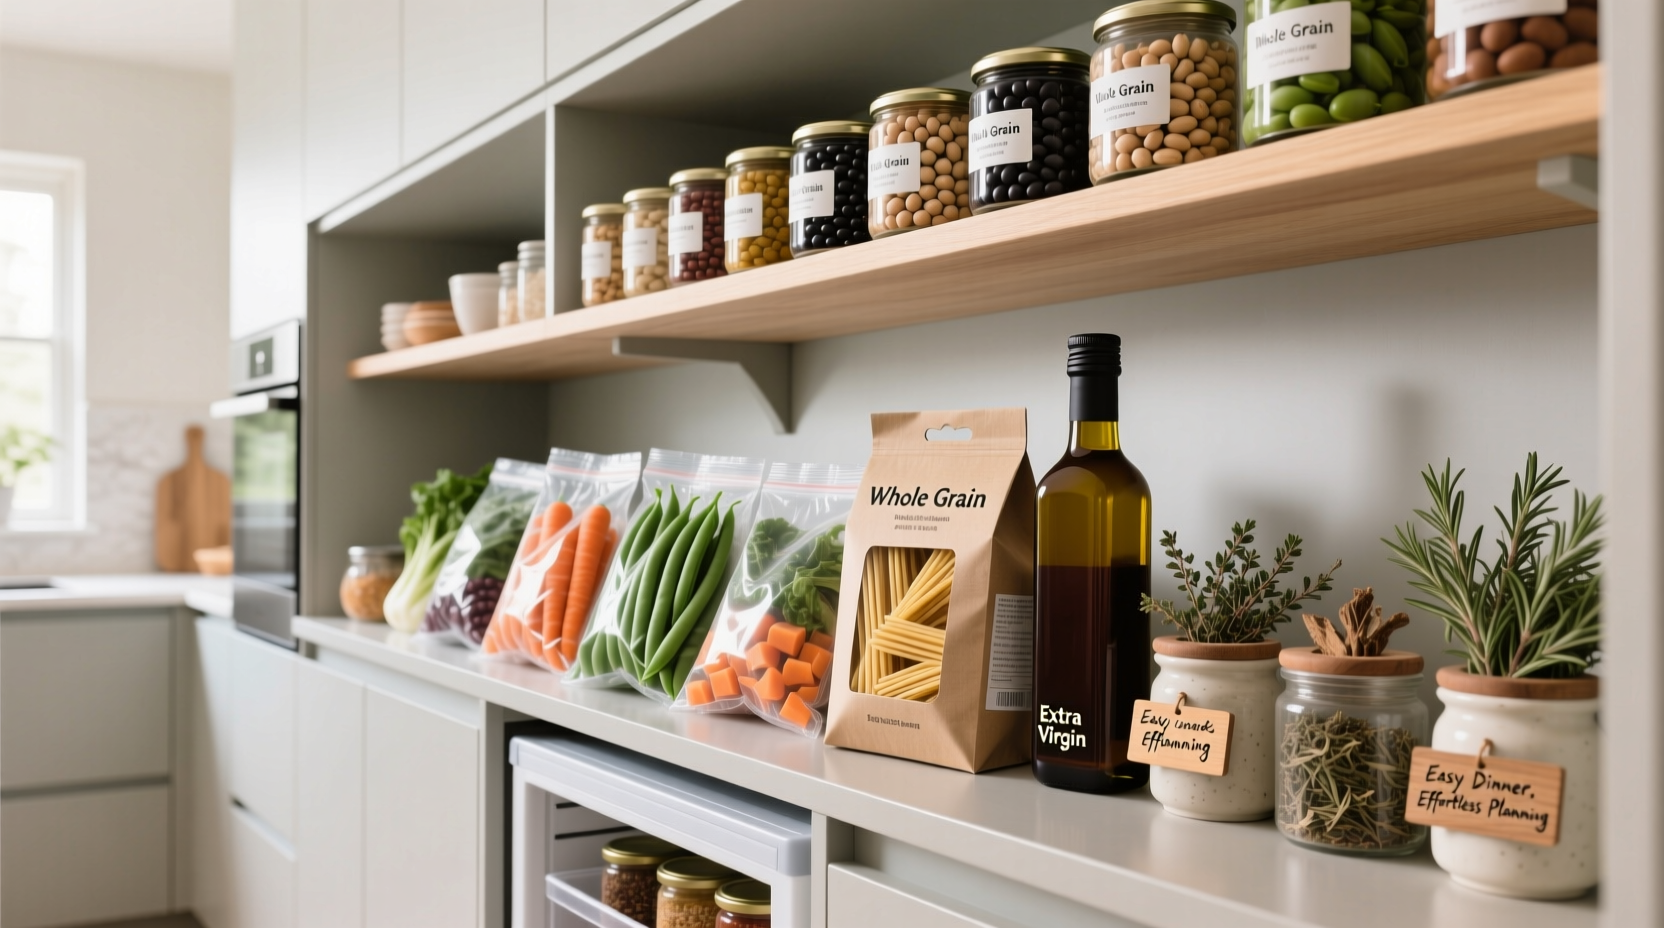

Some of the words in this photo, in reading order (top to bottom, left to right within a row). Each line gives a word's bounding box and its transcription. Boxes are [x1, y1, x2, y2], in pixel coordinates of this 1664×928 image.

[1291, 20, 1334, 38] Grain
[1118, 80, 1155, 97] Grain
[990, 121, 1020, 137] Grain
[870, 486, 929, 507] Whole
[933, 487, 987, 508] Grain
[1040, 704, 1082, 726] Extra
[1037, 724, 1086, 751] Virgin
[1425, 764, 1464, 794] Easy
[1417, 790, 1482, 814] Effortless
[1488, 797, 1549, 833] Planning
